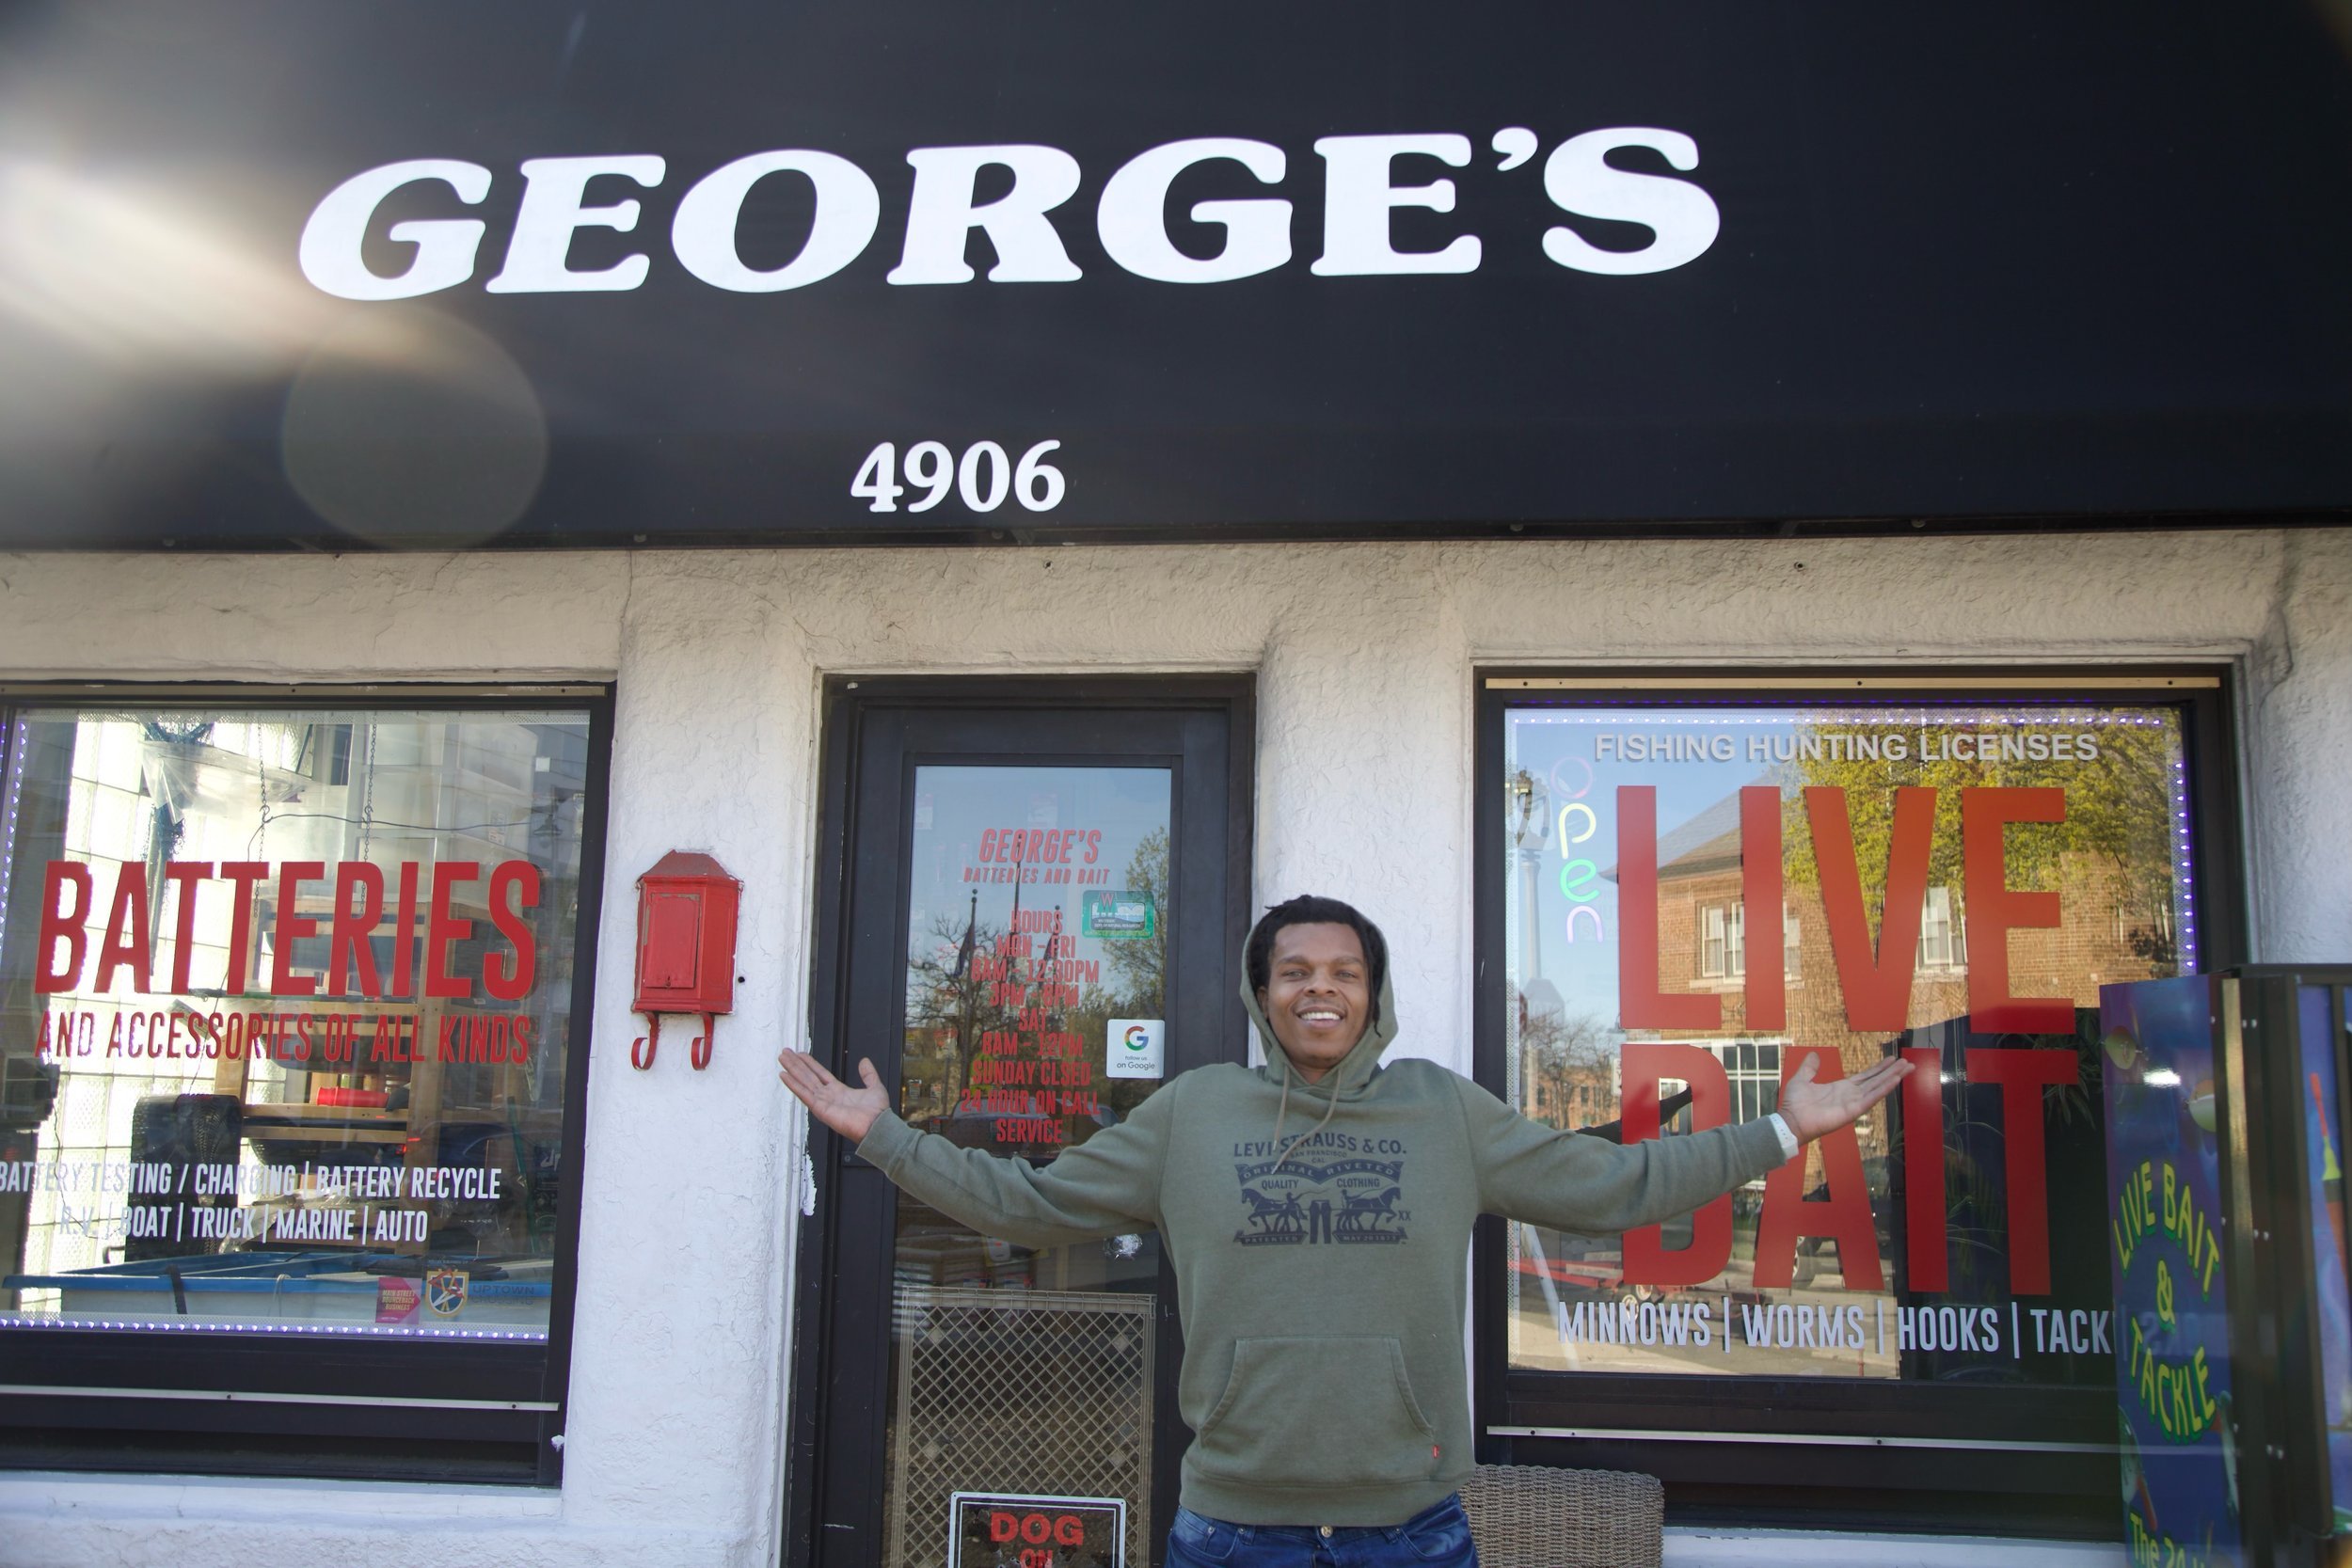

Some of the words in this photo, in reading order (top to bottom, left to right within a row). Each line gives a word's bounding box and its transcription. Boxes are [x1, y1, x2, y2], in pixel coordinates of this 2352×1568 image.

[298, 126, 1720, 302] GEORGE'S
[850, 439, 1066, 514] 4906
[1595, 734, 1736, 762] FISHING
[1747, 734, 1908, 763] HUNTING
[1918, 734, 2099, 761] LICENSES
[978, 828, 1102, 863] GEORGE'S
[963, 867, 1039, 883] BATTERIES
[1043, 868, 1072, 884] AND
[1077, 868, 1110, 884] BAIT
[1010, 910, 1063, 934] HOURS
[1617, 785, 2075, 1034] LIVE
[35, 860, 540, 1000] BATTERIES
[996, 934, 1032, 958] MON
[1050, 936, 1076, 958] FRI
[1025, 959, 1099, 983] 12:30PM
[989, 982, 1026, 1006] 3PM
[1018, 1007, 1048, 1032] SAT
[35, 1011, 94, 1058] AND
[106, 1012, 313, 1061] ACCESSORIES
[325, 1013, 362, 1061] OF
[371, 1014, 425, 1062] ALL
[437, 1015, 530, 1064] KINDS
[982, 1032, 1018, 1055] 8AM
[1038, 1033, 1083, 1057] 12PM
[973, 1059, 1035, 1085] SUNDAY
[1041, 1062, 1092, 1086] CLSED
[1127, 1061, 1155, 1070] Google
[960, 1088, 981, 1114] 24
[987, 1089, 1030, 1115] HOUR
[1036, 1090, 1057, 1116] ON
[1062, 1091, 1102, 1117] CALL
[995, 1118, 1063, 1144] SERVICE
[1234, 1141, 1273, 1157] LEVI
[1362, 1138, 1375, 1153] &
[1378, 1139, 1406, 1155] CO.
[0, 1161, 81, 1193] BATTERY
[91, 1163, 172, 1194] TESTING
[195, 1164, 296, 1196] CHARGING
[315, 1164, 405, 1197] BATTERY
[411, 1167, 502, 1199] RECYCLE
[1243, 1164, 1314, 1179] ORIINAL
[1327, 1163, 1394, 1176] RIVETED
[1621, 1043, 2078, 1295] BAIT
[1261, 1179, 1299, 1190] QUALITY
[1336, 1178, 1380, 1188] CLOTHING
[119, 1205, 172, 1237] BOAT
[191, 1207, 255, 1239] TRUCK
[276, 1208, 356, 1241] MARINE
[374, 1210, 428, 1243] AUTO
[1398, 1210, 1411, 1221] XX
[2113, 1160, 2156, 1272] LIVE
[2163, 1163, 2220, 1296] BAIT
[472, 1285, 534, 1295] UPTOWN
[2156, 1259, 2176, 1327] &
[1559, 1302, 1710, 1347] MINNOWS
[1741, 1304, 1865, 1349] WORMS
[1898, 1306, 1999, 1352] HOOKS
[2130, 1317, 2217, 1437] TACKLE
[991, 1512, 1084, 1545] DOG
